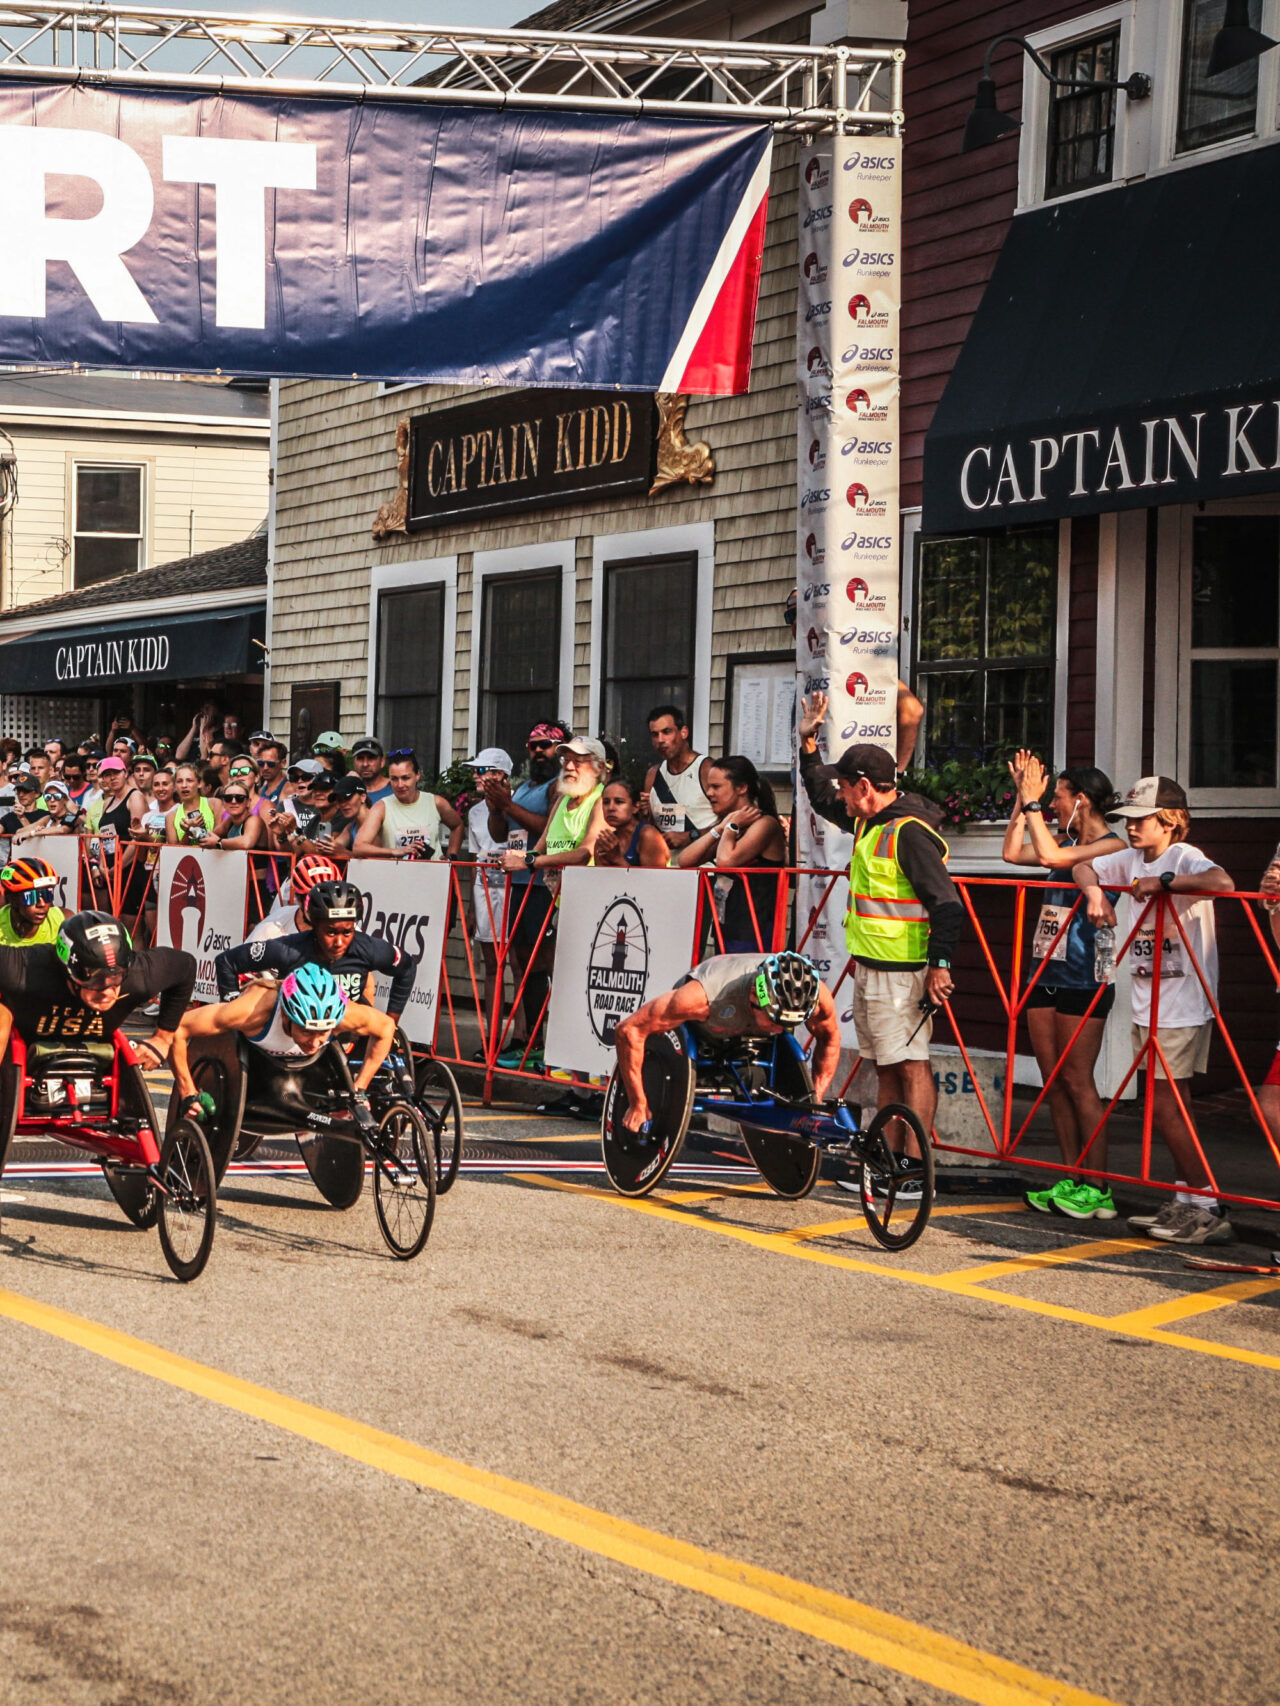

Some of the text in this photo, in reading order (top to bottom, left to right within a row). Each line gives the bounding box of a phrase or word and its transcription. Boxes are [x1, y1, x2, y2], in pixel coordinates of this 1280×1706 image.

[860, 156, 895, 170] asics
[856, 172, 892, 183] Runkeeper
[859, 252, 895, 265] asics
[856, 268, 891, 278] Runkeeper
[859, 348, 894, 360] asics
[855, 363, 891, 372] Runkeeper
[427, 400, 632, 497] CAPTAIN KIDD
[857, 441, 892, 454] asics
[853, 457, 889, 467] Runkeeper
[960, 411, 1207, 511] CAPTAIN
[856, 536, 892, 549] asics
[853, 552, 888, 561] Runkeeper
[857, 631, 892, 643] asics
[852, 646, 889, 656] Runkeeper
[55, 636, 170, 680] CAPTAIN KIDD
[858, 725, 892, 737] asics
[659, 814, 677, 827] 790
[546, 840, 577, 849] ALMOUTH
[1138, 928, 1155, 937] Thom
[213, 933, 232, 951] asics
[197, 959, 218, 982] MOU
[589, 969, 645, 992] FALMOUTH
[758, 980, 766, 1000] W3
[417, 988, 435, 1010] body
[594, 993, 636, 1014] ROAD RACE
[36, 1016, 104, 1037] USA
